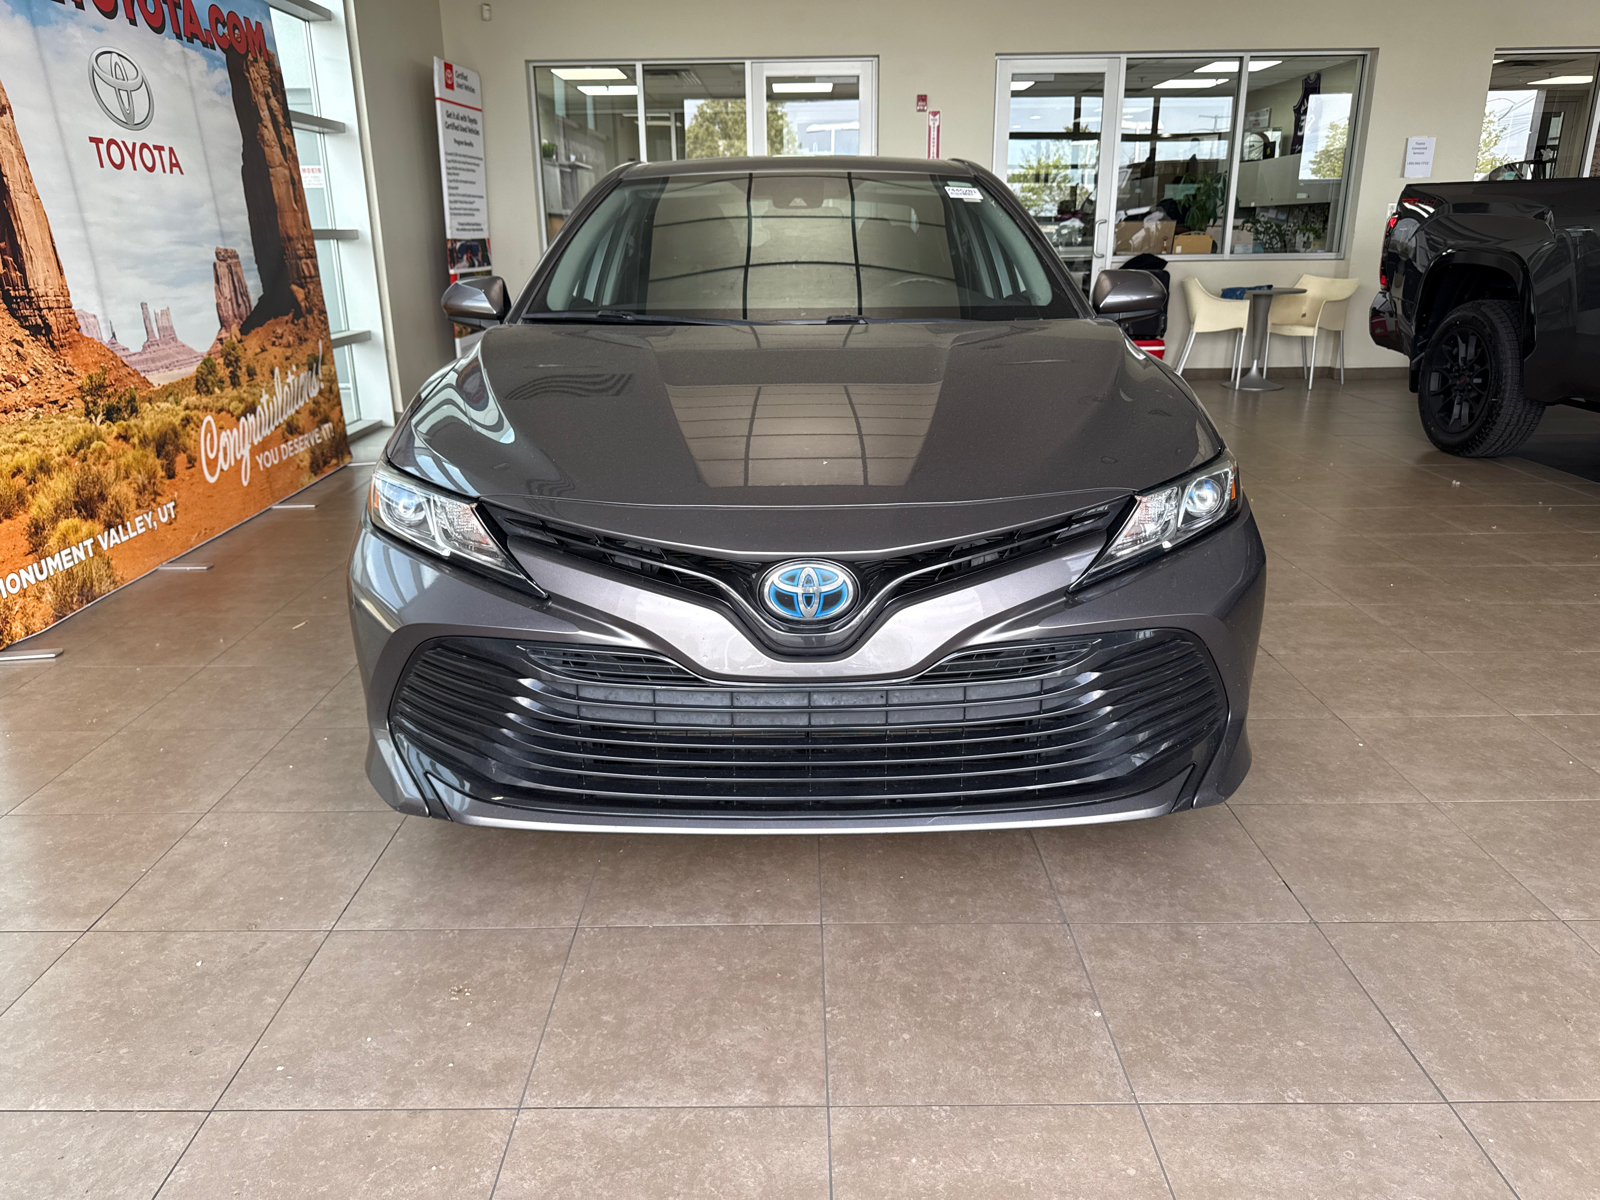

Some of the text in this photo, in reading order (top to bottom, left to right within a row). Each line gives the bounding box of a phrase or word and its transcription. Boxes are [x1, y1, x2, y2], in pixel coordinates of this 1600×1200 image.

[54, 0, 268, 62] OTA.COM
[88, 136, 184, 175] TOYOTA
[200, 339, 325, 487] Congratulations!
[255, 421, 335, 471] YOU DESERVE IT!
[97, 510, 159, 551] VALLEY,
[157, 501, 176, 524] UT
